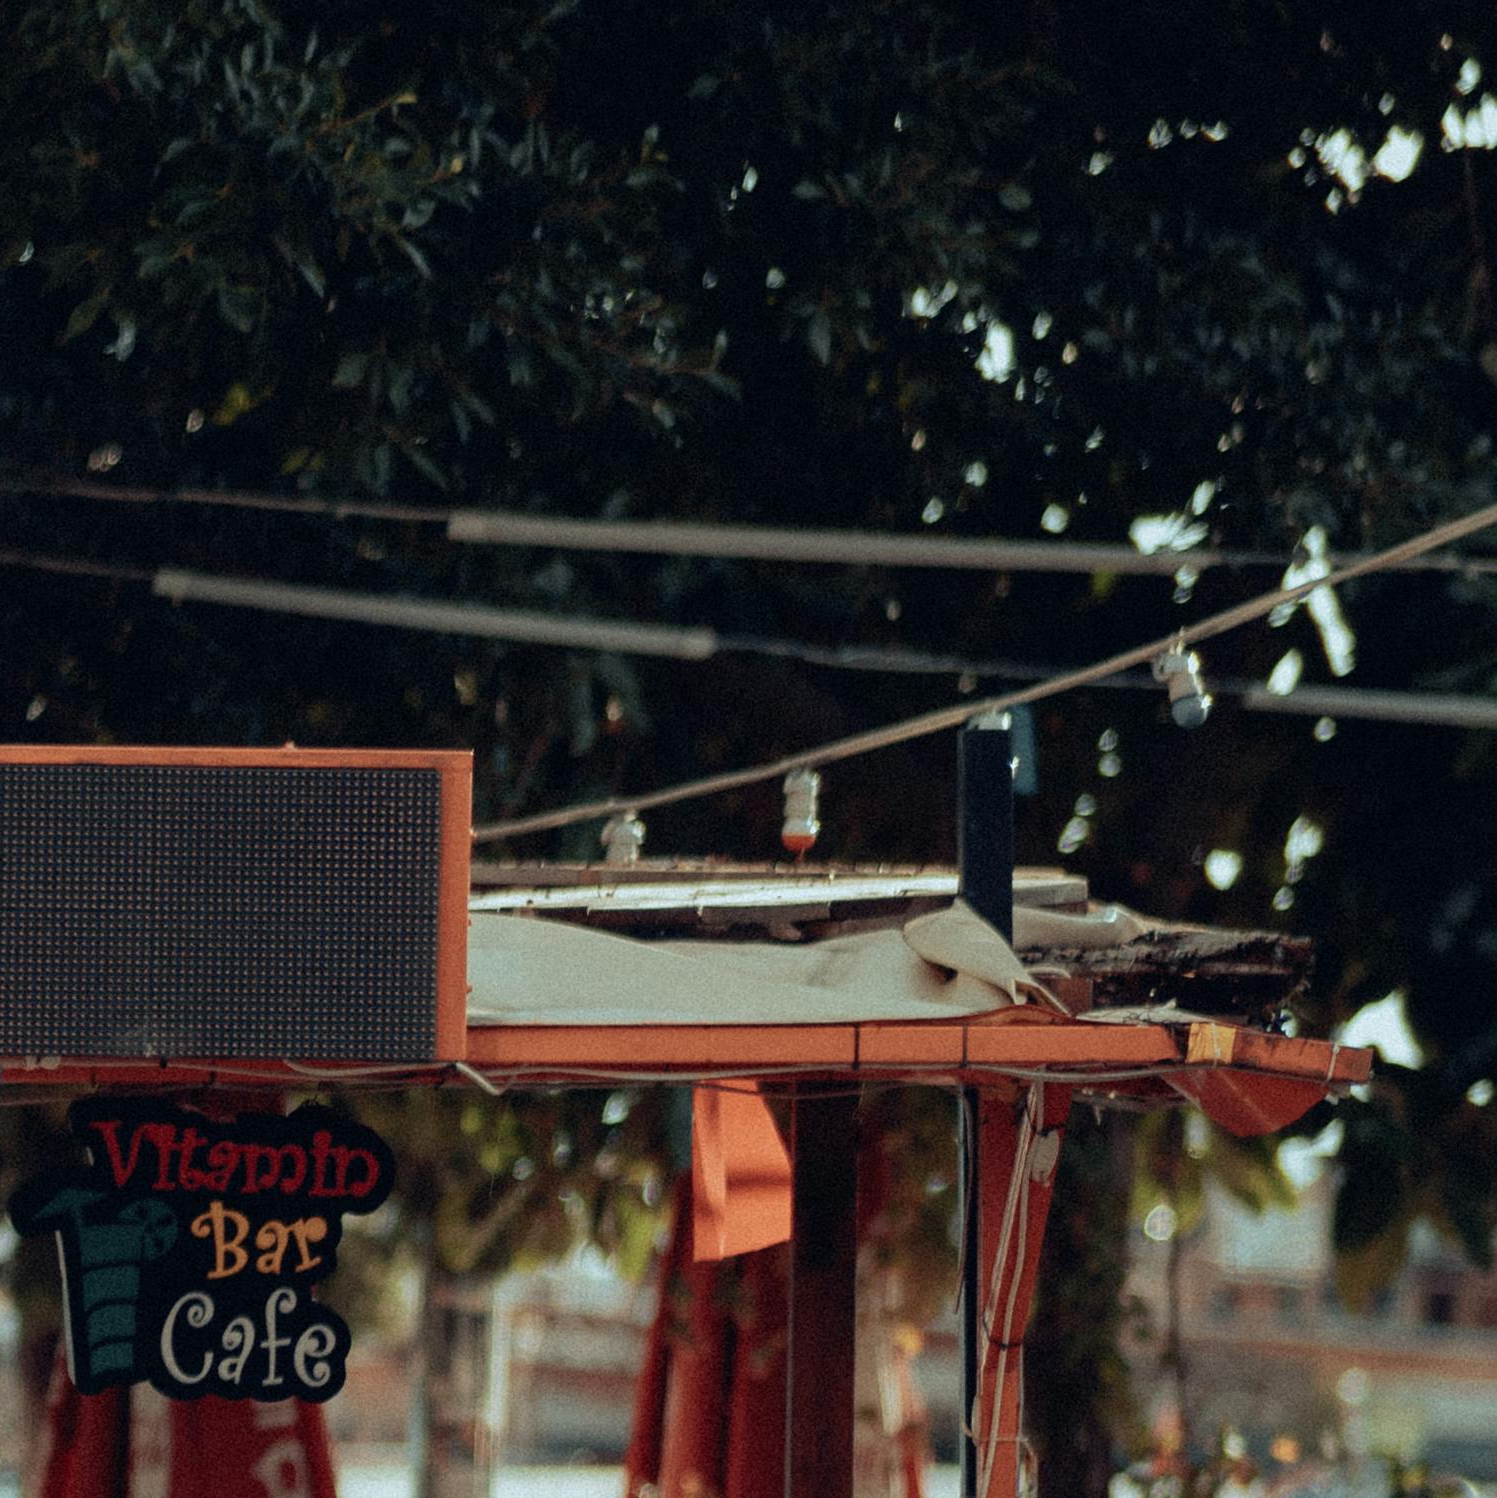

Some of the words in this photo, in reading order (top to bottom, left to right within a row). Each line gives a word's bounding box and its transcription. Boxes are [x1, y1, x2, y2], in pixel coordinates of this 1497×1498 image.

[90, 1120, 381, 1198] Vitamin
[190, 1200, 329, 1280] Bar
[160, 1286, 337, 1388] Cafe
